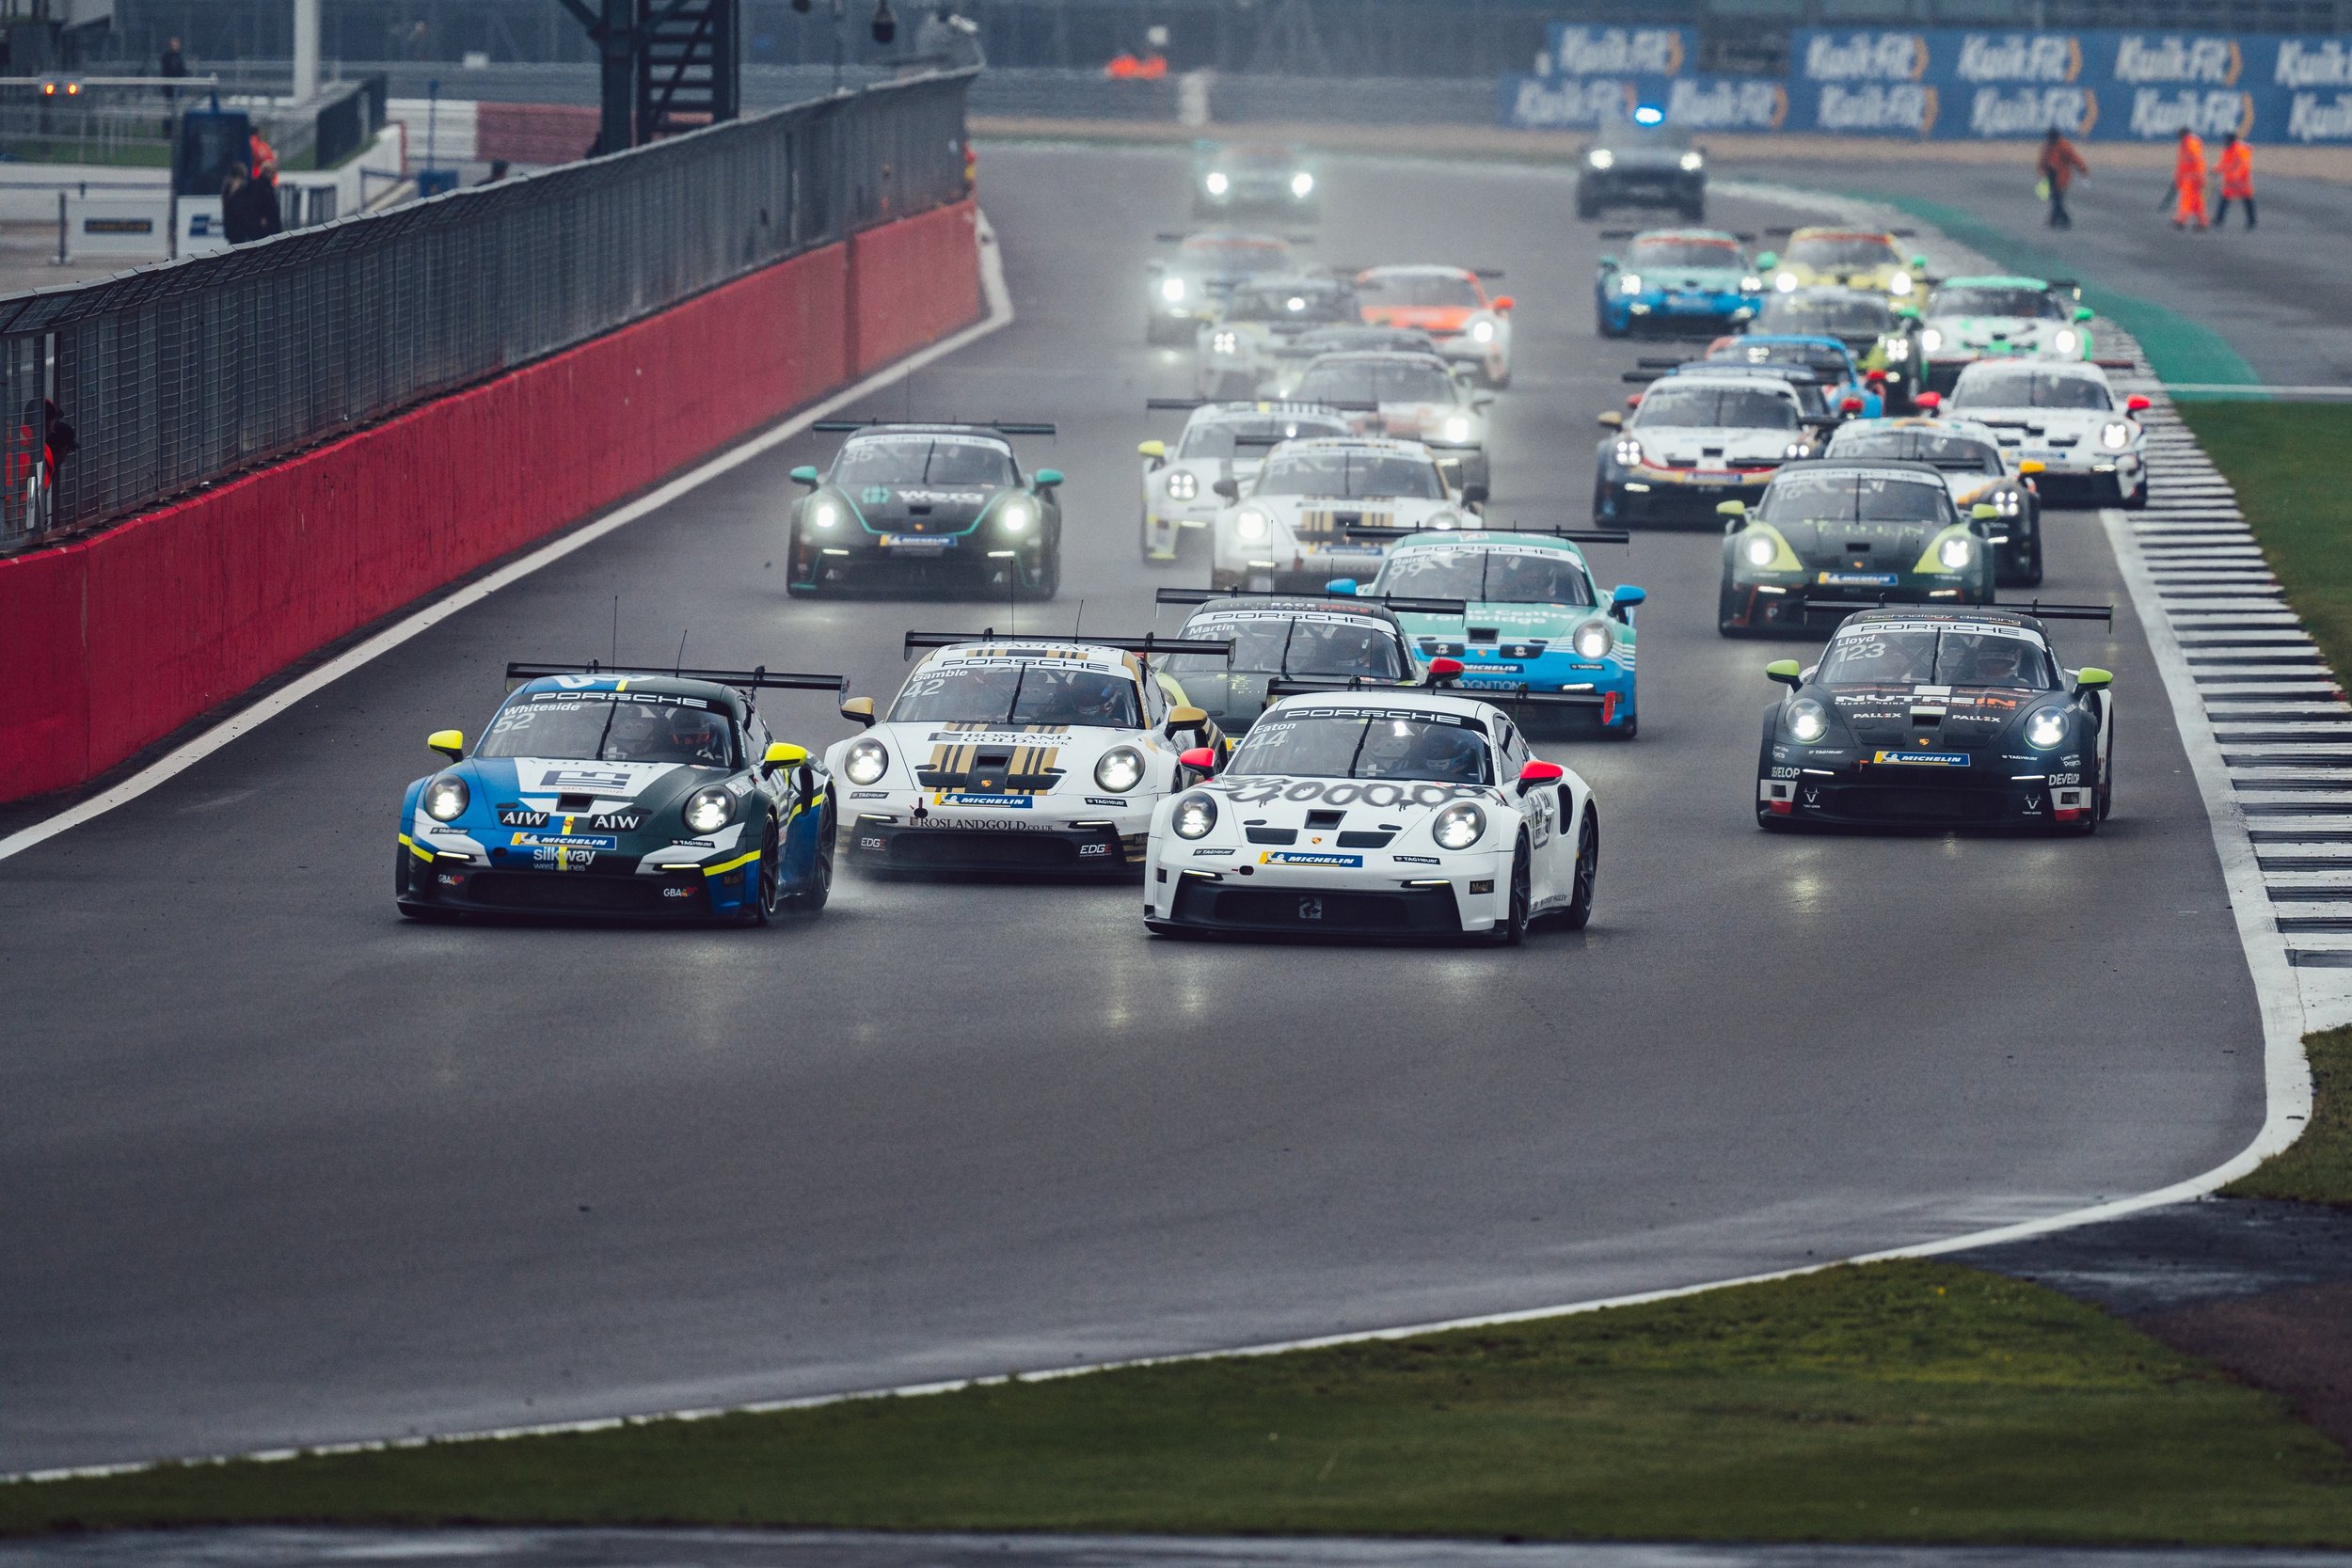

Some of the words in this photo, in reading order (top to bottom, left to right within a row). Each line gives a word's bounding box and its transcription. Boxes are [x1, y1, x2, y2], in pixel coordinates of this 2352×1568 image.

[1413, 545, 1560, 557] PORSCHE
[1212, 612, 1373, 626] PORSCHE
[1188, 623, 1235, 636] Martin
[1860, 624, 2021, 637] PORSCHE
[1836, 634, 1877, 647] Lloyd
[1835, 641, 1887, 663] 123
[941, 658, 1110, 673] PORSCHE
[913, 668, 968, 682] Gamble
[902, 678, 946, 699] 42
[532, 691, 707, 708] PORSCHE
[504, 702, 581, 717] Whiteside
[1284, 708, 1462, 725] PORSCHE
[492, 712, 536, 735] 52
[1254, 721, 1297, 736] Eaton
[967, 733, 1073, 741] ROSLAND
[1245, 730, 1288, 751] 44
[1900, 754, 1963, 763] MICHELIN
[2048, 772, 2080, 786] DEVELOP
[961, 796, 1025, 806] MICHELIN
[501, 811, 548, 826] AIW
[594, 815, 640, 830] AIW
[540, 836, 609, 846] MICHELIN
[860, 837, 887, 847] EDGE
[1080, 843, 1112, 854] EDGE
[1288, 855, 1355, 864] MICHELIN
[533, 863, 553, 871] west
[663, 888, 682, 897] GBA
